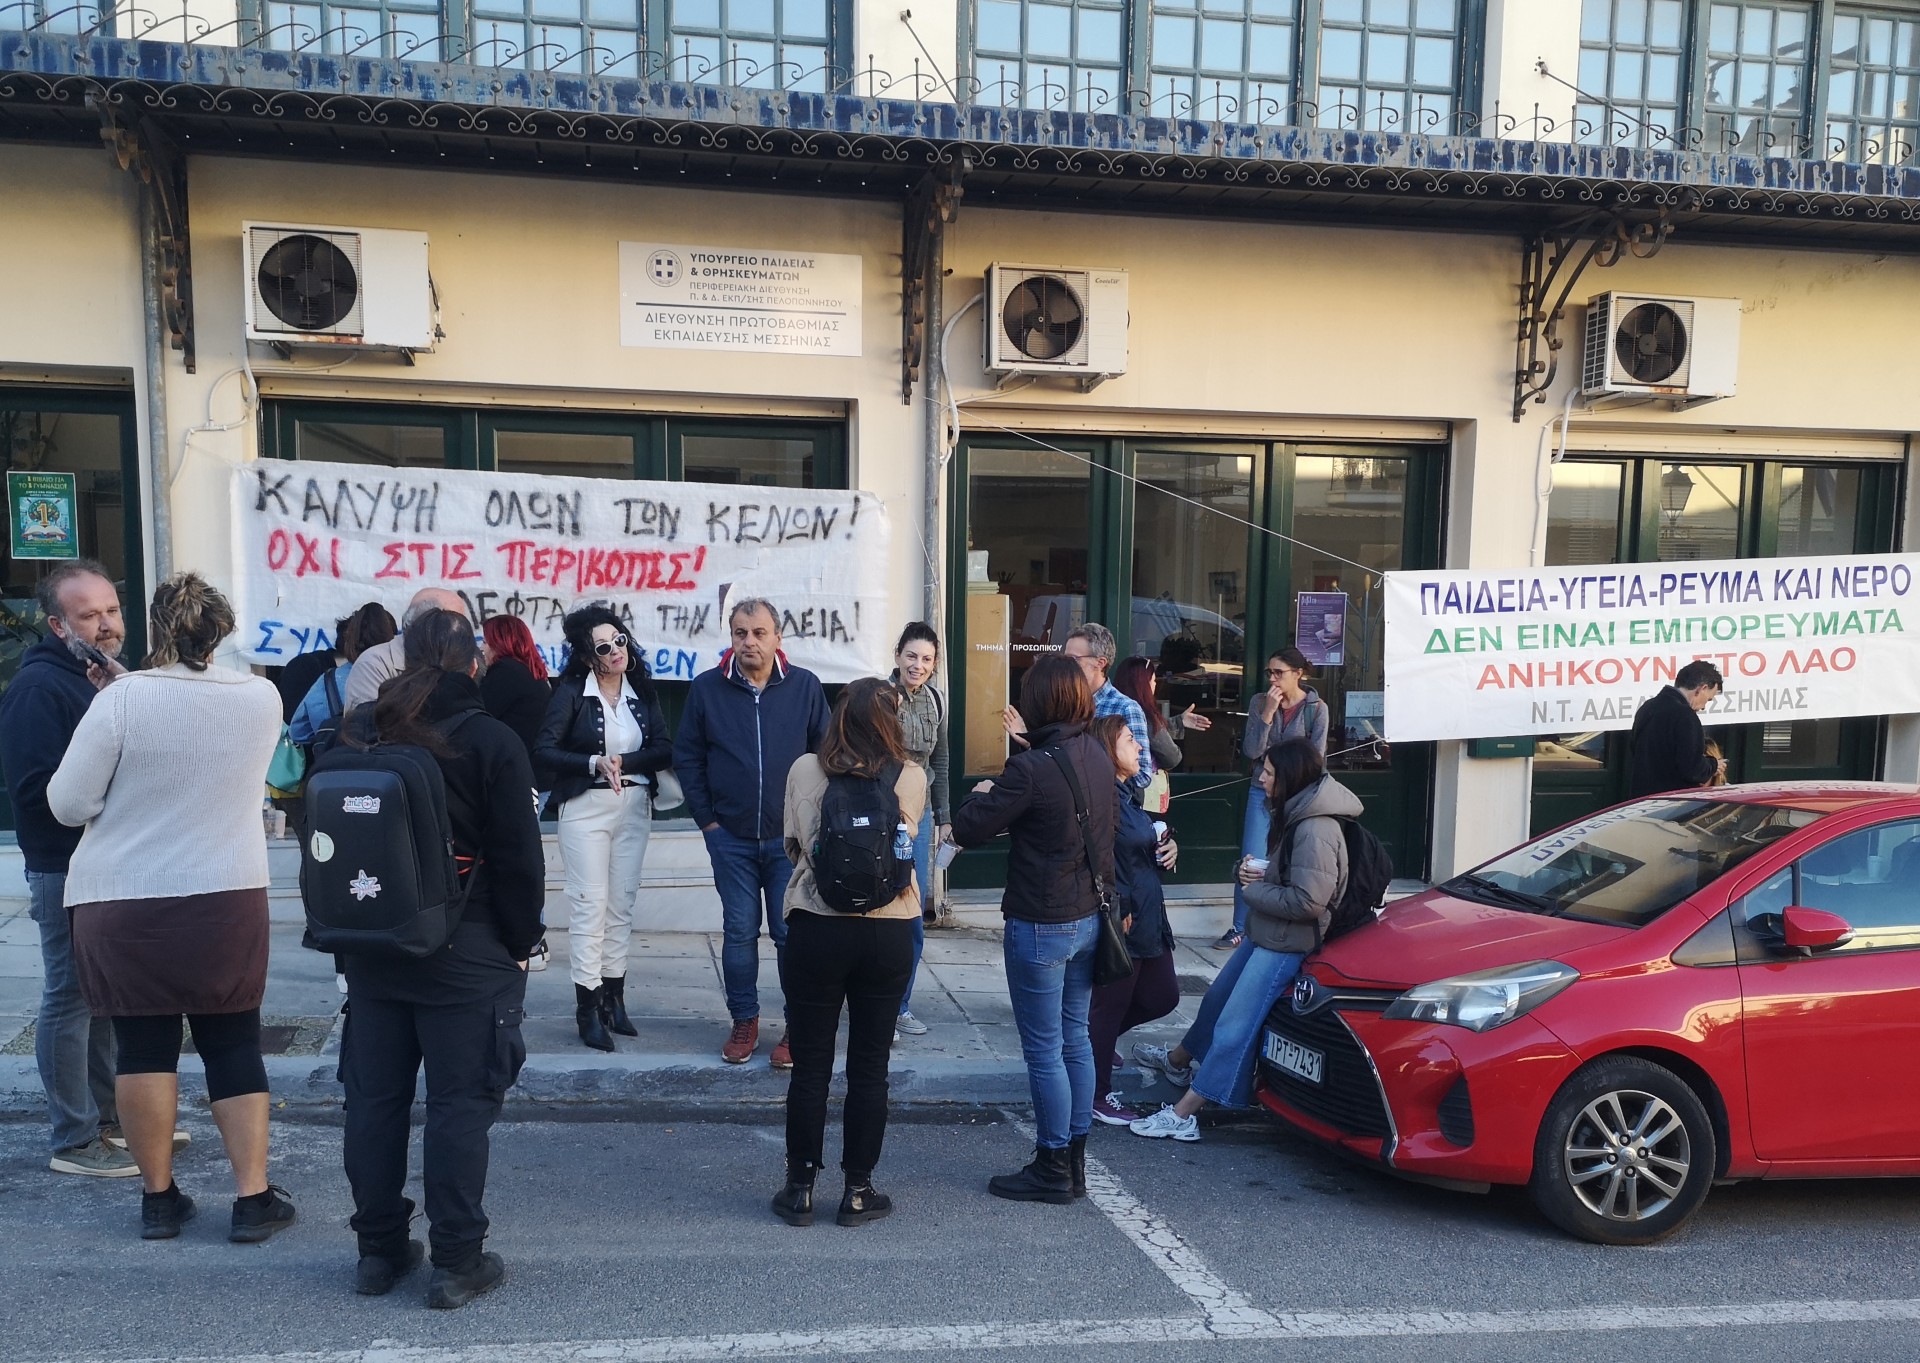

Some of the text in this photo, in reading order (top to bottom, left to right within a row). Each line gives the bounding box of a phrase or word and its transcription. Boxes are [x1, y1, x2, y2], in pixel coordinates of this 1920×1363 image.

[690, 253, 815, 269] ΥΠΟΥΡΓΕΙΟ ΠΑΙΔΕΙΑΣ
[690, 267, 800, 281] & ΘΡΗΣΚΕΥΜΑΤΩΝ
[690, 282, 810, 295] ΠΕΡΙΦΕΡΕΙΑΚΗ ΔΙΕΥΘΥΝΣΗ
[690, 293, 699, 301] Π.
[711, 294, 720, 302] Δ.
[722, 295, 764, 304] ΕΚΠ/ΣΗΣ
[766, 297, 843, 308] ΠΕΛΟΠΟΝΝΗΣΟΥ
[645, 312, 840, 331] ΔΙΕΥΘΥΝΣΗ ΠΡΩΤΟΒΑΘΜΙΑΣ
[654, 329, 832, 347] ΕΚΠΑΙΔΕΥΣΗΣ ΜΕΣΣΗΝΙΑΣ
[255, 469, 860, 544] ΚΑΛΥΨΗ ΟΛΩΝ ΤΩΝ ΚΕΝΩΝ!
[267, 528, 706, 593] ΟΧΙ ΣΤΙΣ ΠΕΡΙΚΟΠΕΣ!
[1419, 563, 1912, 616] ΠΑΙΔΕΙΑ-ΥΓΕΙΑ-ΡΕΥΜΑ ΚΑΙ ΝΕΡΟ
[656, 602, 711, 639] ΤΗΝ
[1424, 608, 1904, 655] ΔΕΝ ΕΙΝΑΙ ΕΜΠΟΡΕΥΜΑΤΑ
[975, 643, 1004, 651] ΤΜΗΜΑ
[1012, 644, 1063, 652] ΠΡΟΣΩΠΙΚΟΥ
[1476, 655, 1677, 690] ΑΝΗΚΟΥΝ
[1776, 645, 1857, 675] ΛΑΟ
